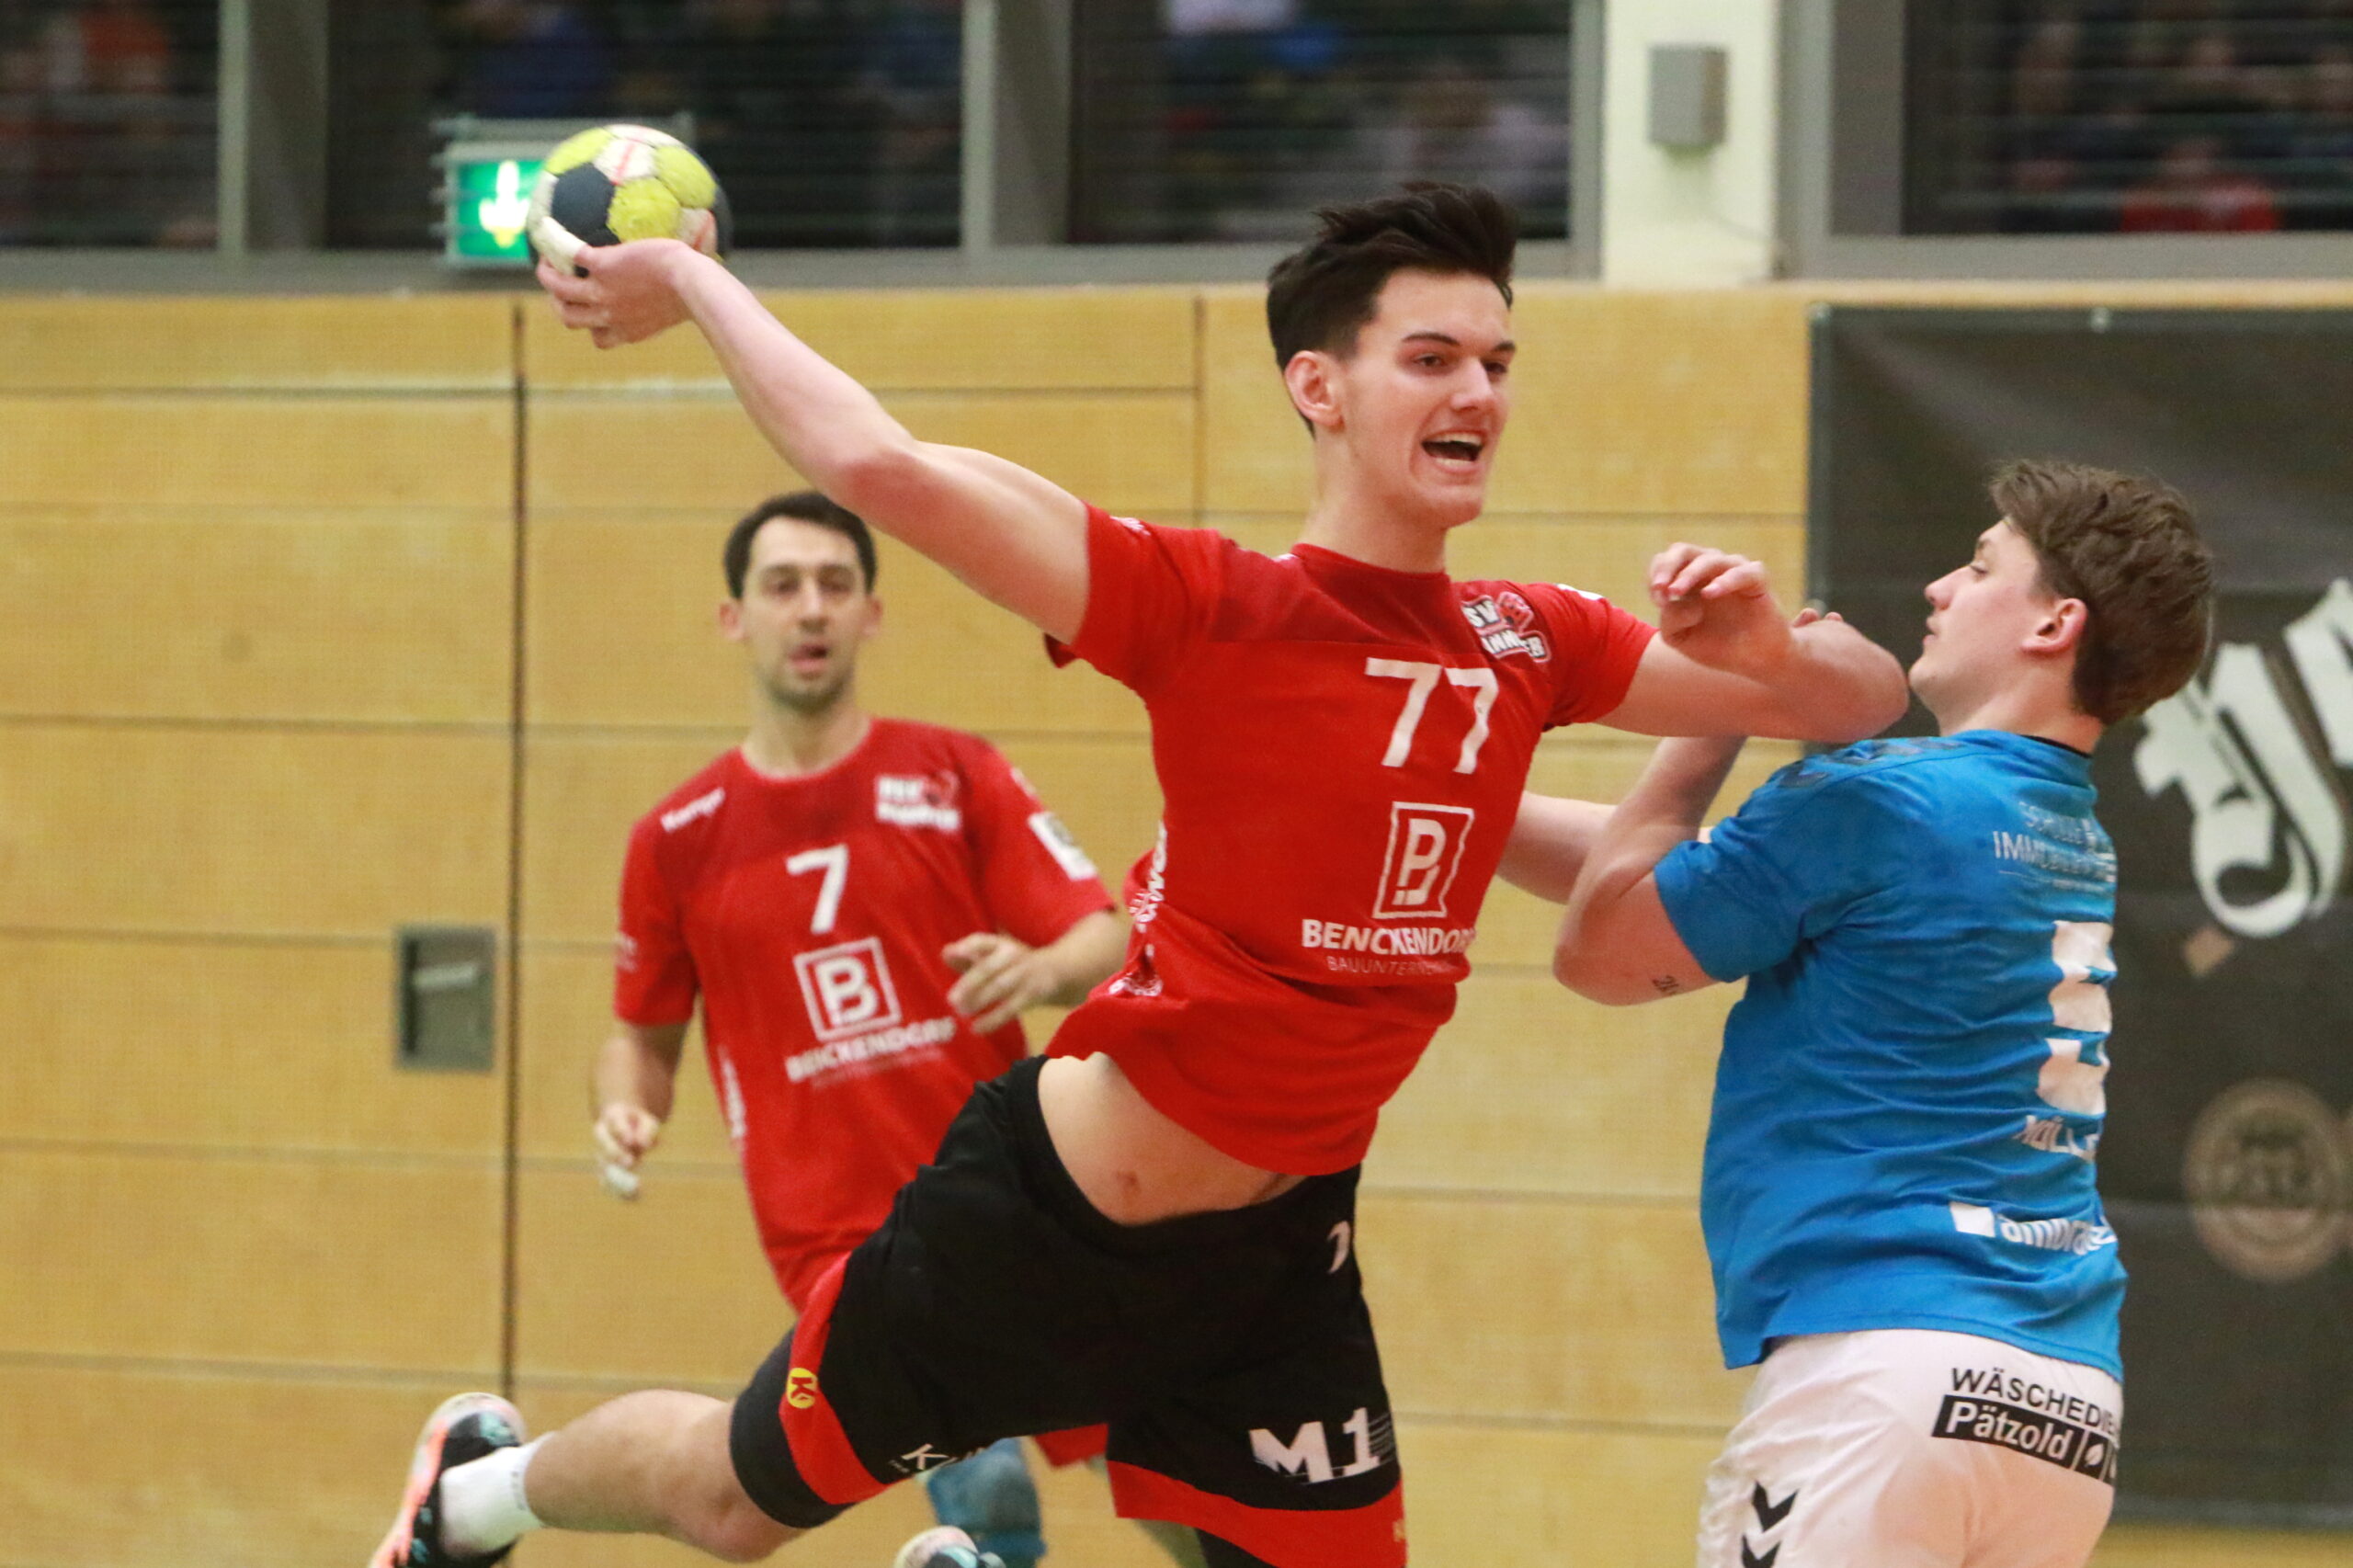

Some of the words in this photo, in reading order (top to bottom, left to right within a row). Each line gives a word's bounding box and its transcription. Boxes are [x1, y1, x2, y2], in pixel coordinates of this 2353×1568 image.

[1364, 657, 1500, 775] 77
[785, 844, 848, 935] 7
[815, 954, 880, 1028] B
[1248, 1406, 1381, 1483] M1
[1945, 1401, 2075, 1460] Pätzold
